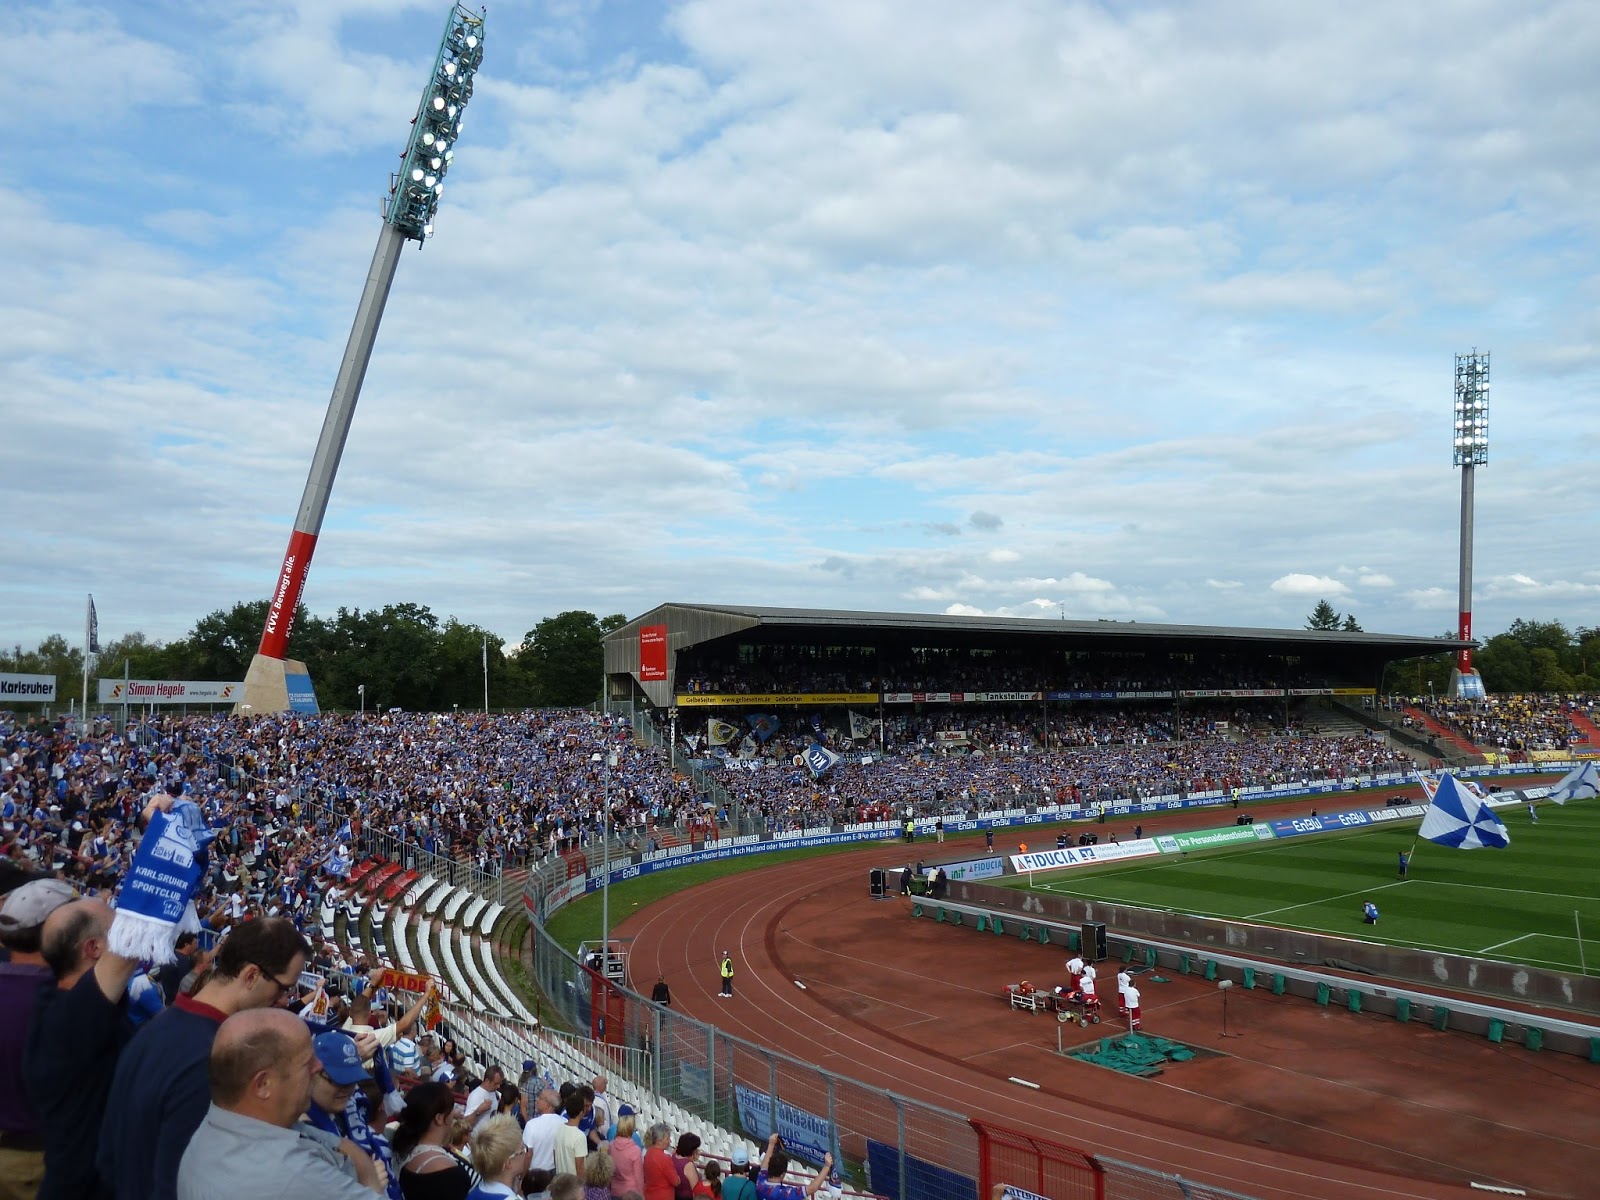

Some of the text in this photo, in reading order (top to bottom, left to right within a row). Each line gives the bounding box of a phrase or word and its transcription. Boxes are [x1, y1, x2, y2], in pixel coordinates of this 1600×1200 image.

[267, 555, 295, 634] KVV. Bewegt alle.
[1, 681, 53, 694] Karlsruher
[129, 683, 185, 698] Simon Hegele
[985, 692, 1029, 700] Tankstellen
[942, 814, 966, 822] MARKISEN
[978, 808, 1026, 819] KLAIBER MARKISEN
[1024, 815, 1042, 823] EnBW
[1055, 812, 1072, 820] EnBW
[1338, 812, 1366, 825] EnBW
[1368, 808, 1396, 821] KLAIBER
[843, 821, 873, 832] KLAIBER
[958, 821, 977, 830] EnBW
[992, 818, 1010, 827] EnBW
[1292, 817, 1322, 831] EnBW
[773, 826, 831, 840] KLAIBER MARKISEN
[922, 826, 936, 834] EnB
[733, 834, 760, 845] MARKISEN
[1178, 829, 1255, 847] Ihr Personaldienstleister
[642, 844, 692, 862] KLAIBER MARKISEN
[652, 862, 664, 870] Ideen
[733, 847, 745, 855] Nach
[746, 843, 765, 853] Mailand
[779, 840, 800, 849] Madrid?
[801, 837, 830, 846] Hauptsache
[1024, 849, 1077, 869] FIDUCIA
[623, 865, 640, 878] EnBW
[974, 861, 1002, 871] FIDUCIA
[135, 866, 188, 889] KARLSRUHER
[951, 867, 965, 879] init
[132, 880, 181, 901] SPORTCLUB
[384, 973, 426, 993] BADE
